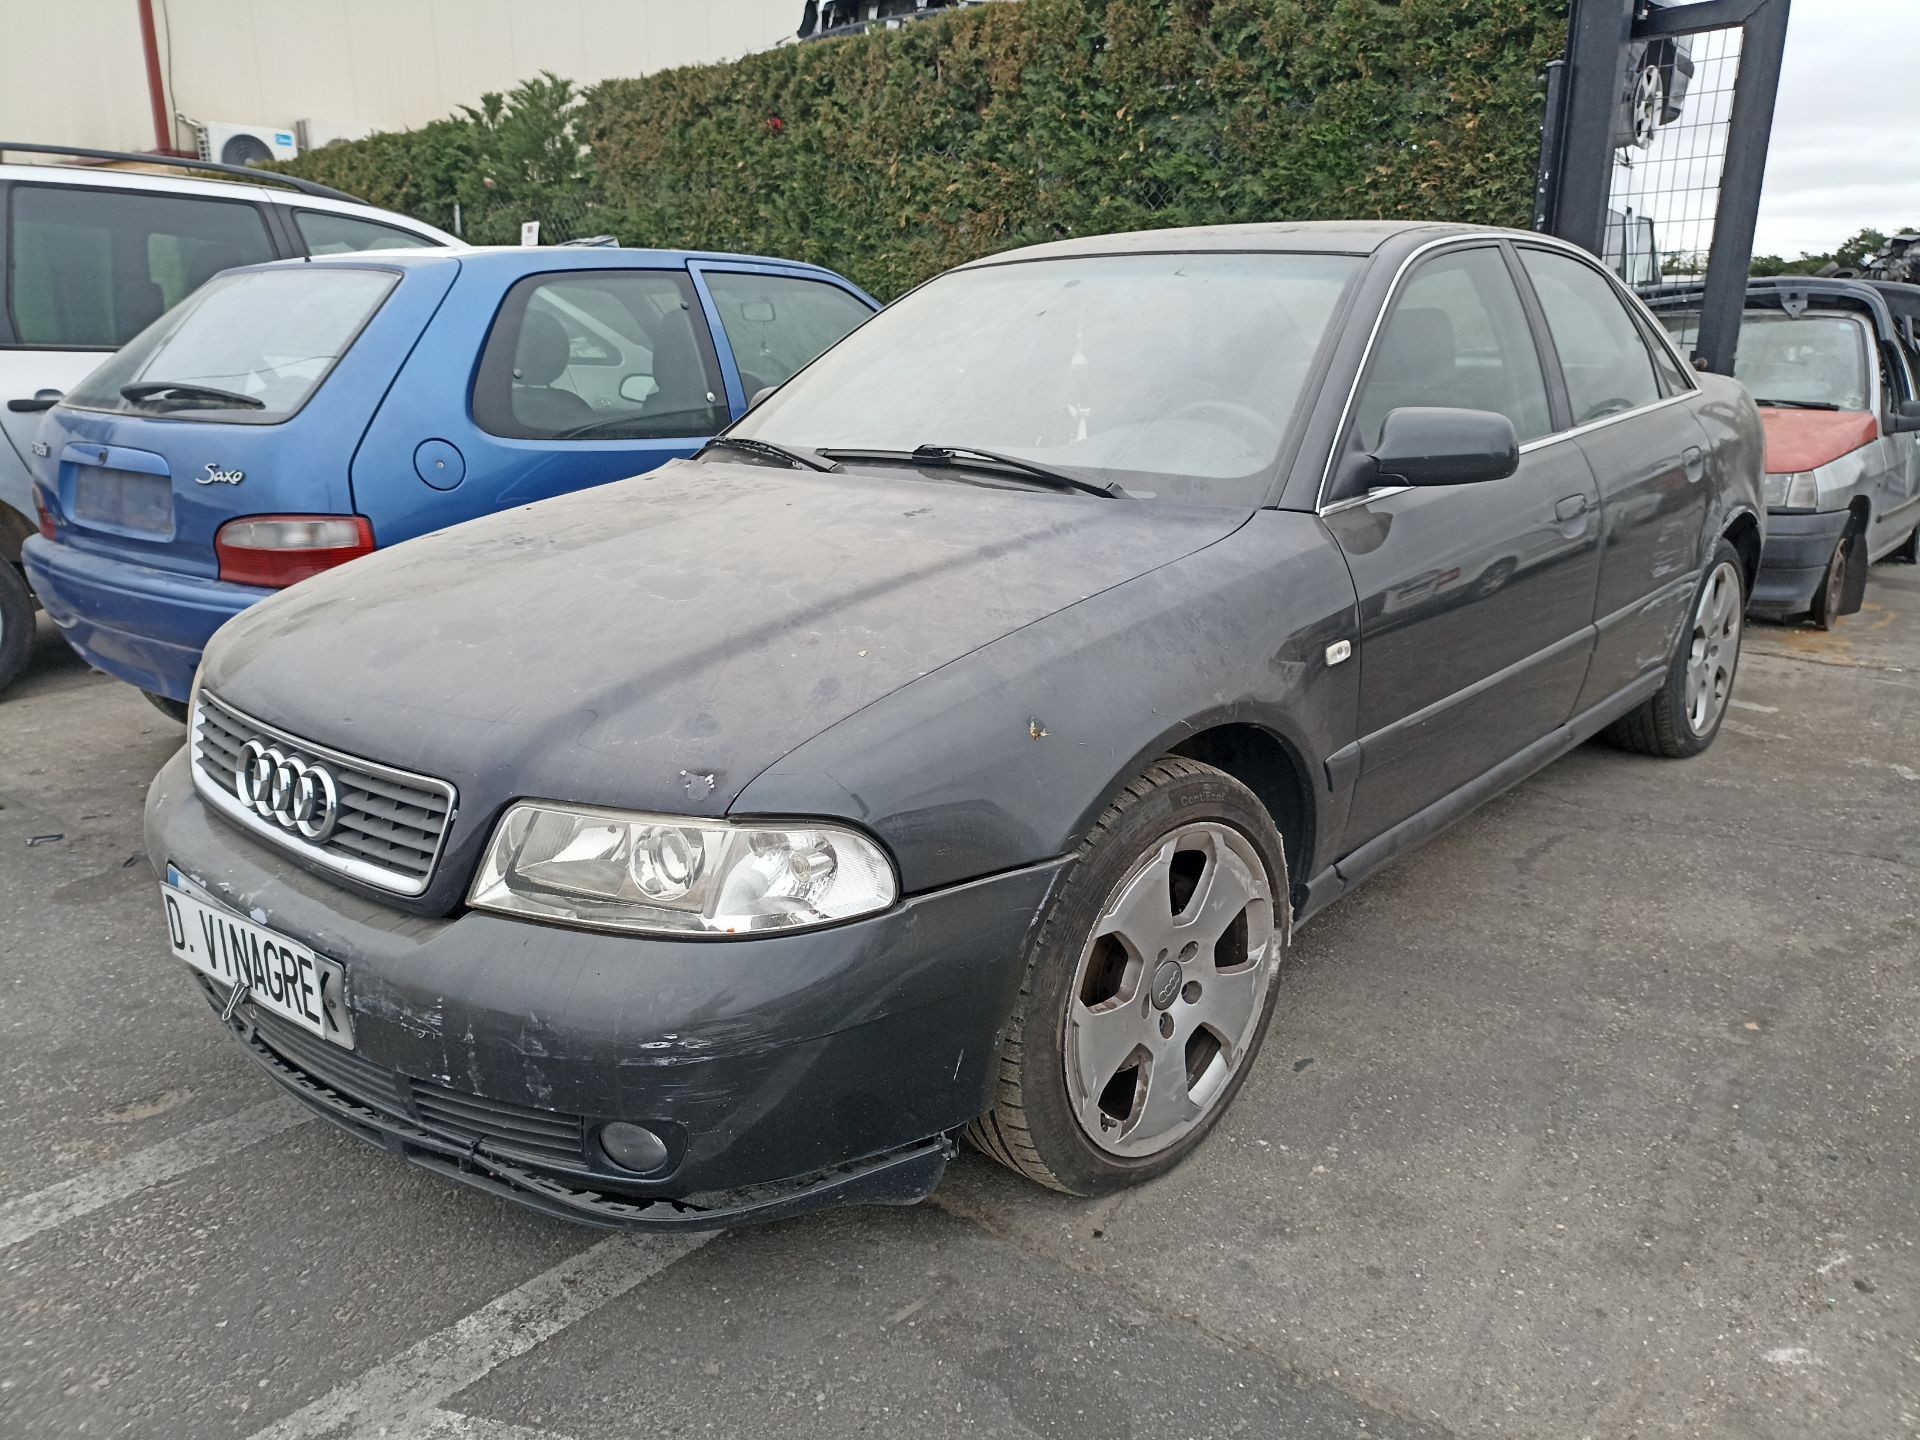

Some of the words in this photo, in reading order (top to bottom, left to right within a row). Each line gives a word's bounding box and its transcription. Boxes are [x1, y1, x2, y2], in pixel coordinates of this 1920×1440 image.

[195, 463, 243, 484] Saxo
[165, 893, 195, 952] D.
[198, 909, 321, 1026] VINAGRE
